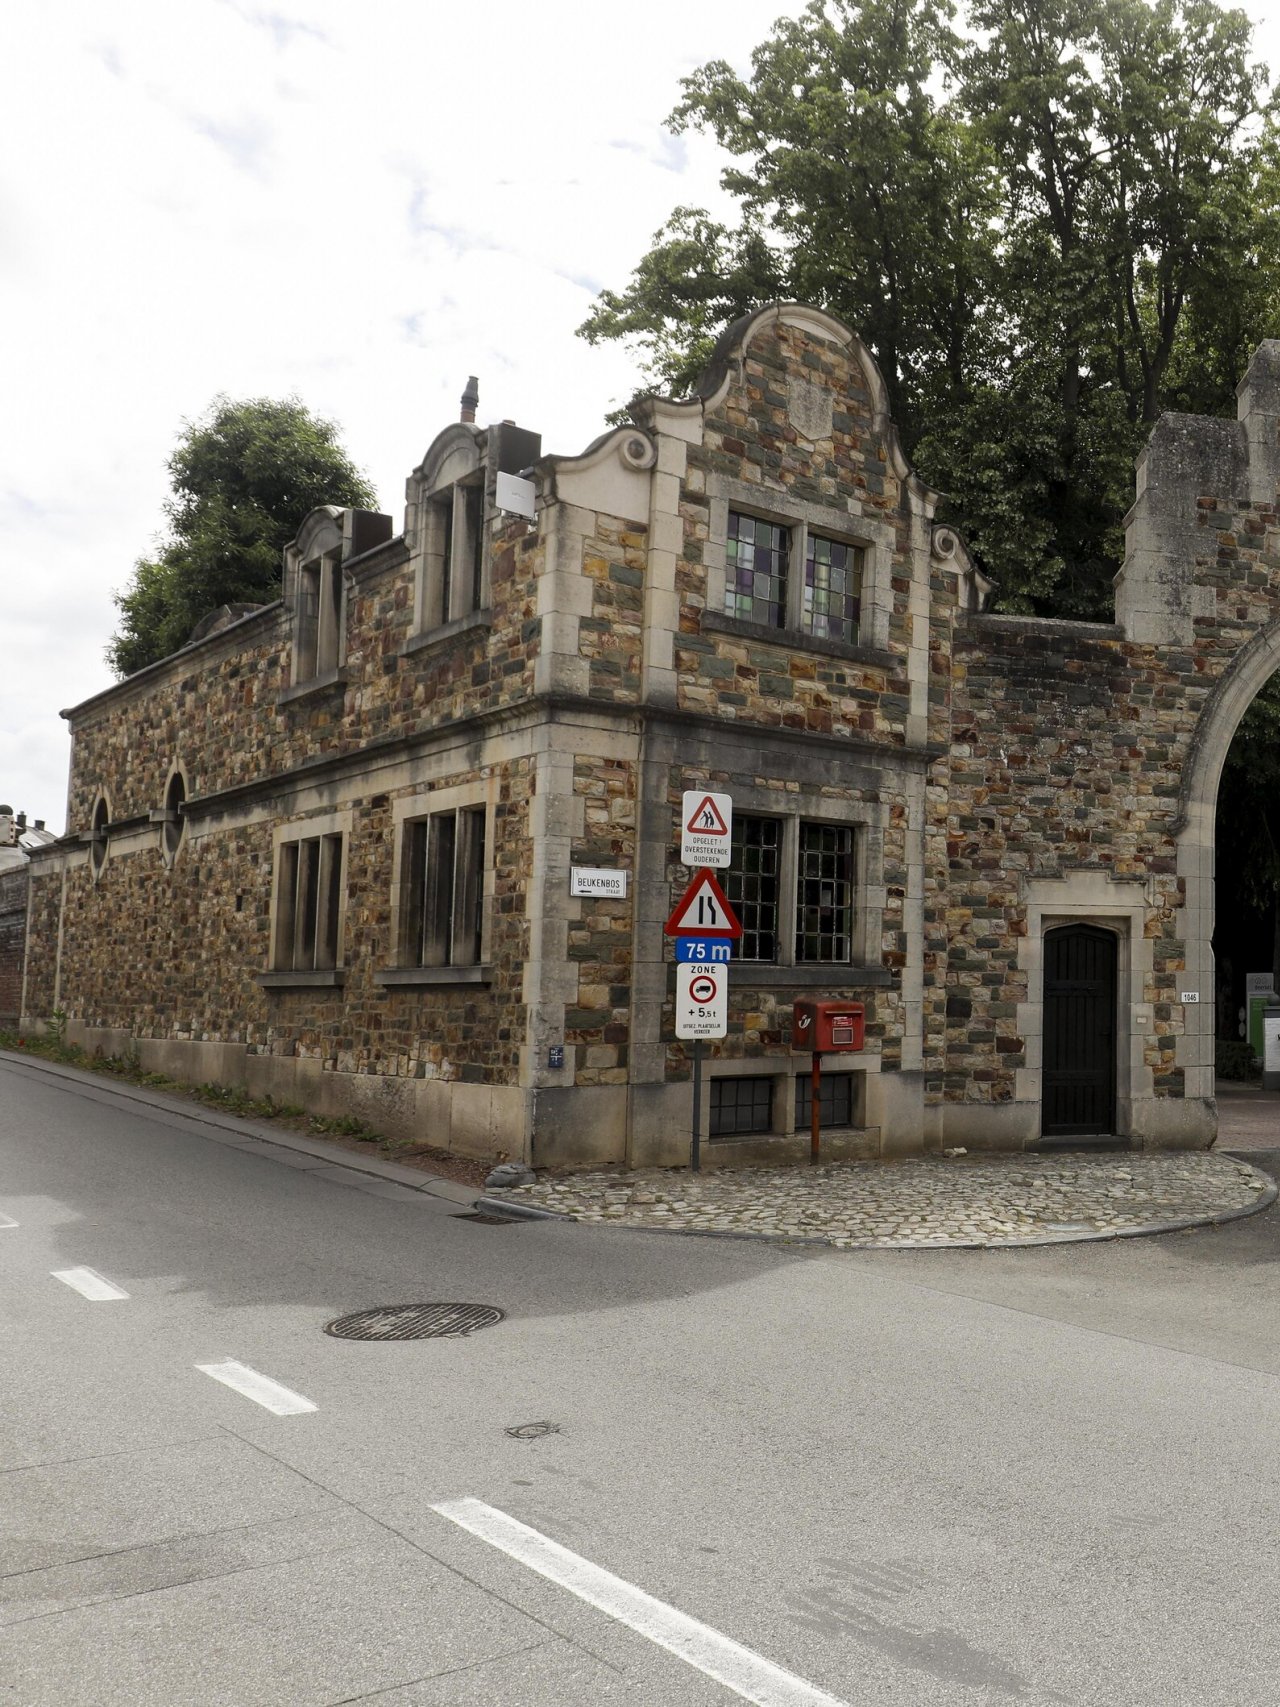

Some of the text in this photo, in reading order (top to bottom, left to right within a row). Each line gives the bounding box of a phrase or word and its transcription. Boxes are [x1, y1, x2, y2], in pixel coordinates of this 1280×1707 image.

[692, 837, 718, 846] OPGELET
[684, 846, 728, 855] OVERSTEKENDE
[577, 877, 620, 888] BEUKENBOS
[686, 943, 731, 960] 75 m
[690, 965, 717, 974] ZONE
